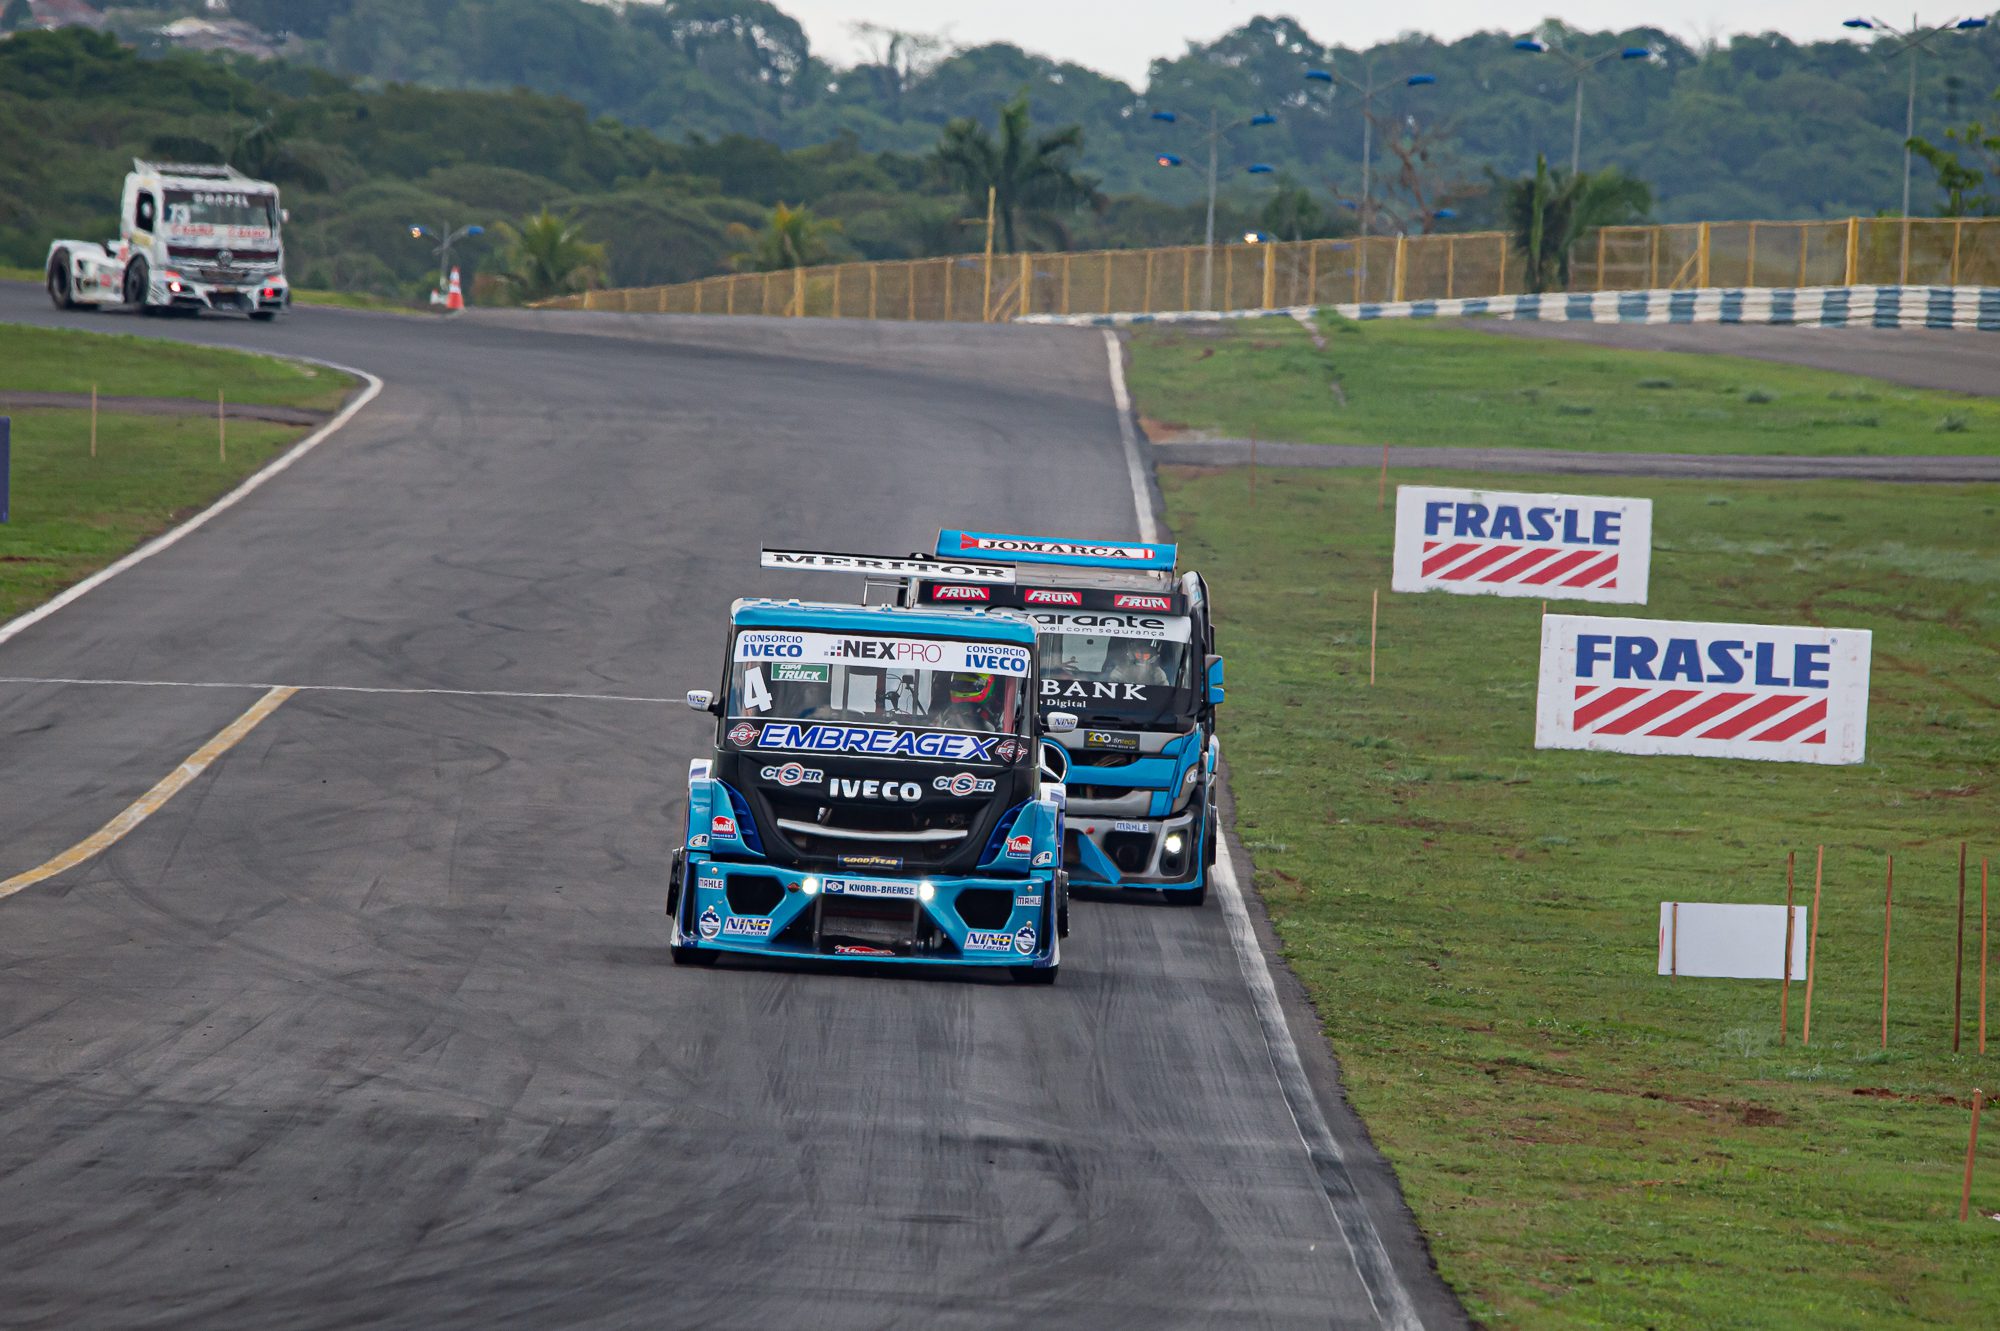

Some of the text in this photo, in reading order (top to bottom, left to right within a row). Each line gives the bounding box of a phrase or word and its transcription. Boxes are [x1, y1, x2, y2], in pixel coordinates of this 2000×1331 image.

[983, 539, 1130, 557] JOMARCA
[773, 554, 1006, 578] MERITOR
[935, 586, 987, 599] FRUM
[1026, 590, 1078, 604] FRUM
[1117, 596, 1168, 609] FRUM
[742, 643, 803, 658] IVECO
[965, 653, 1026, 673] IVECO
[778, 669, 822, 681] TRUCK
[743, 666, 773, 712] 4
[1040, 679, 1148, 701] BANK
[1046, 698, 1087, 709] Digital
[759, 724, 999, 762] EMBREAGEX
[830, 778, 923, 802] IVECO
[699, 879, 723, 889] MAHLE
[849, 883, 915, 896] KNORR-BREMSE
[1016, 896, 1041, 906] MAHLE
